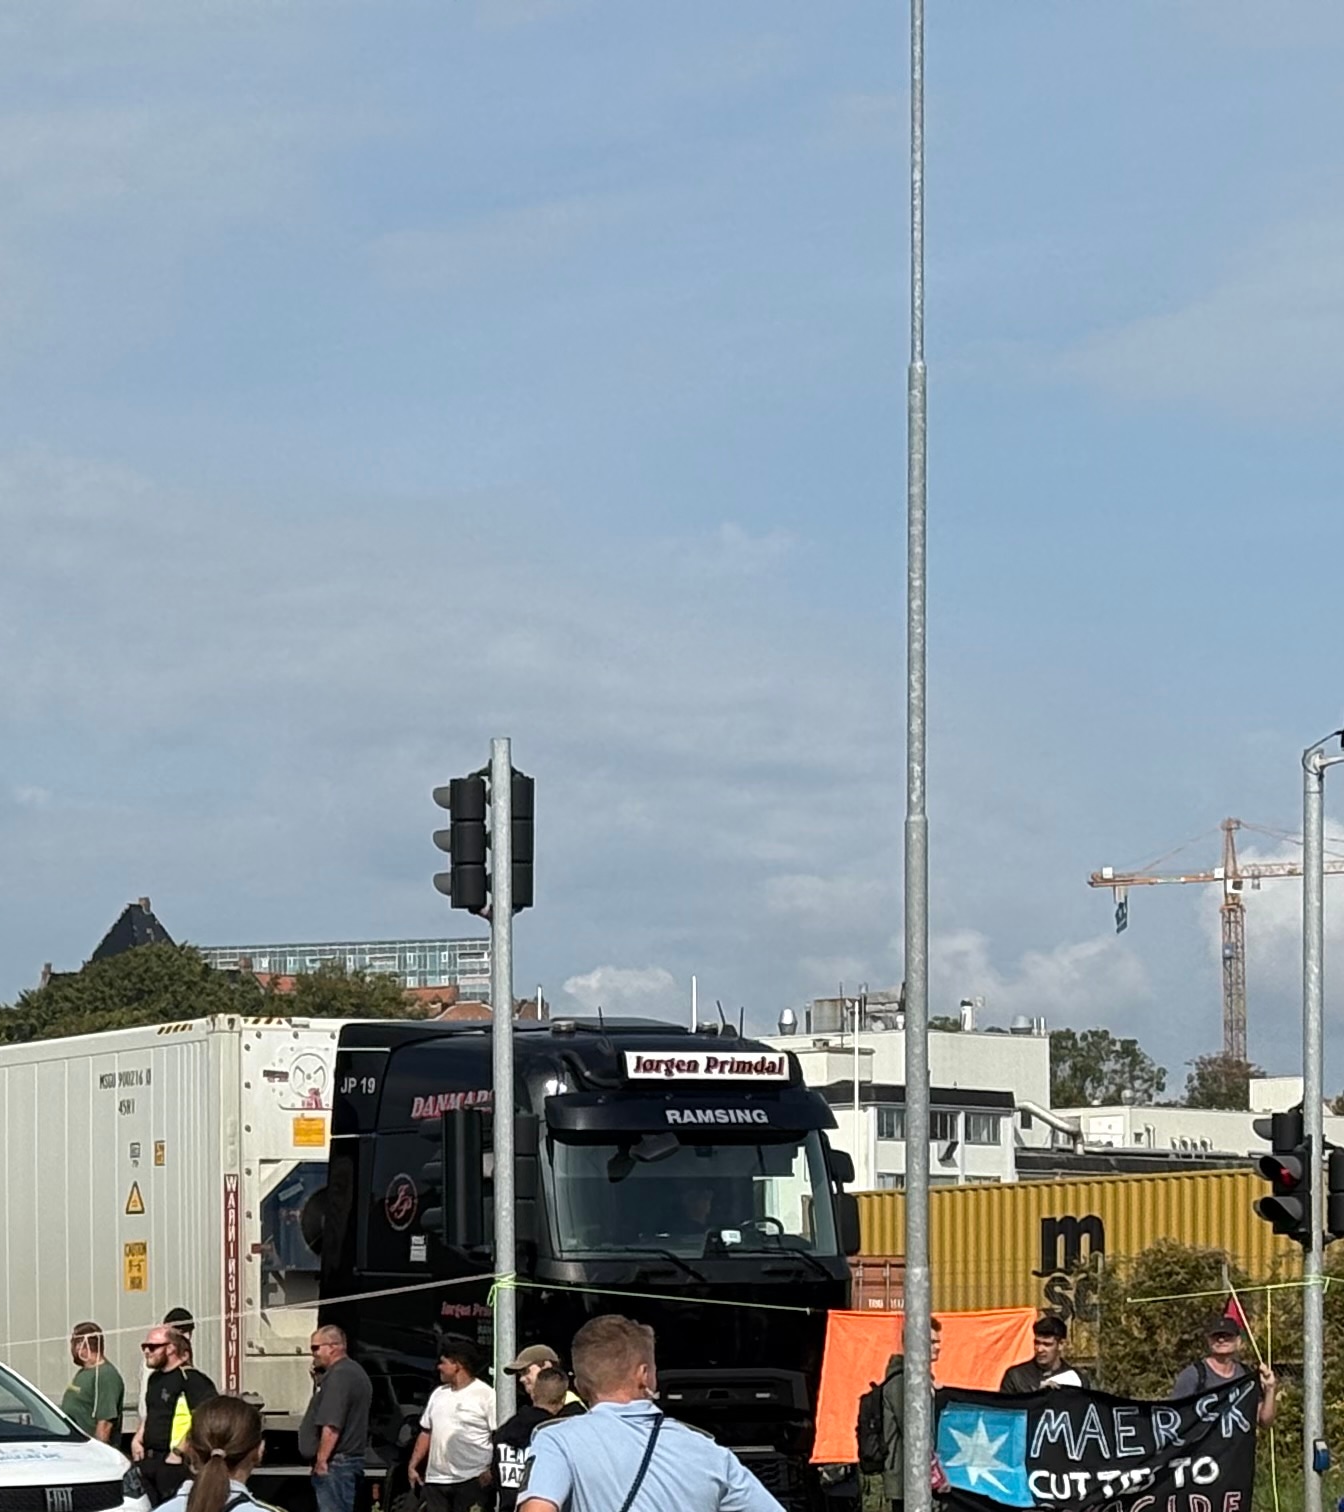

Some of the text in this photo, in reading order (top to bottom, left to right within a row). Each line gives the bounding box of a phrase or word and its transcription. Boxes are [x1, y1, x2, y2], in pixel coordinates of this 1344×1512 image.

[634, 1055, 785, 1077] Jørgen Primdal
[340, 1077, 376, 1094] JP 19
[665, 1109, 769, 1125] RAMSING
[1030, 1380, 1255, 1461] MAERSK
[1028, 1470, 1091, 1500] CUT
[1169, 1456, 1220, 1488] TO
[45, 1487, 74, 1512] FIAT
